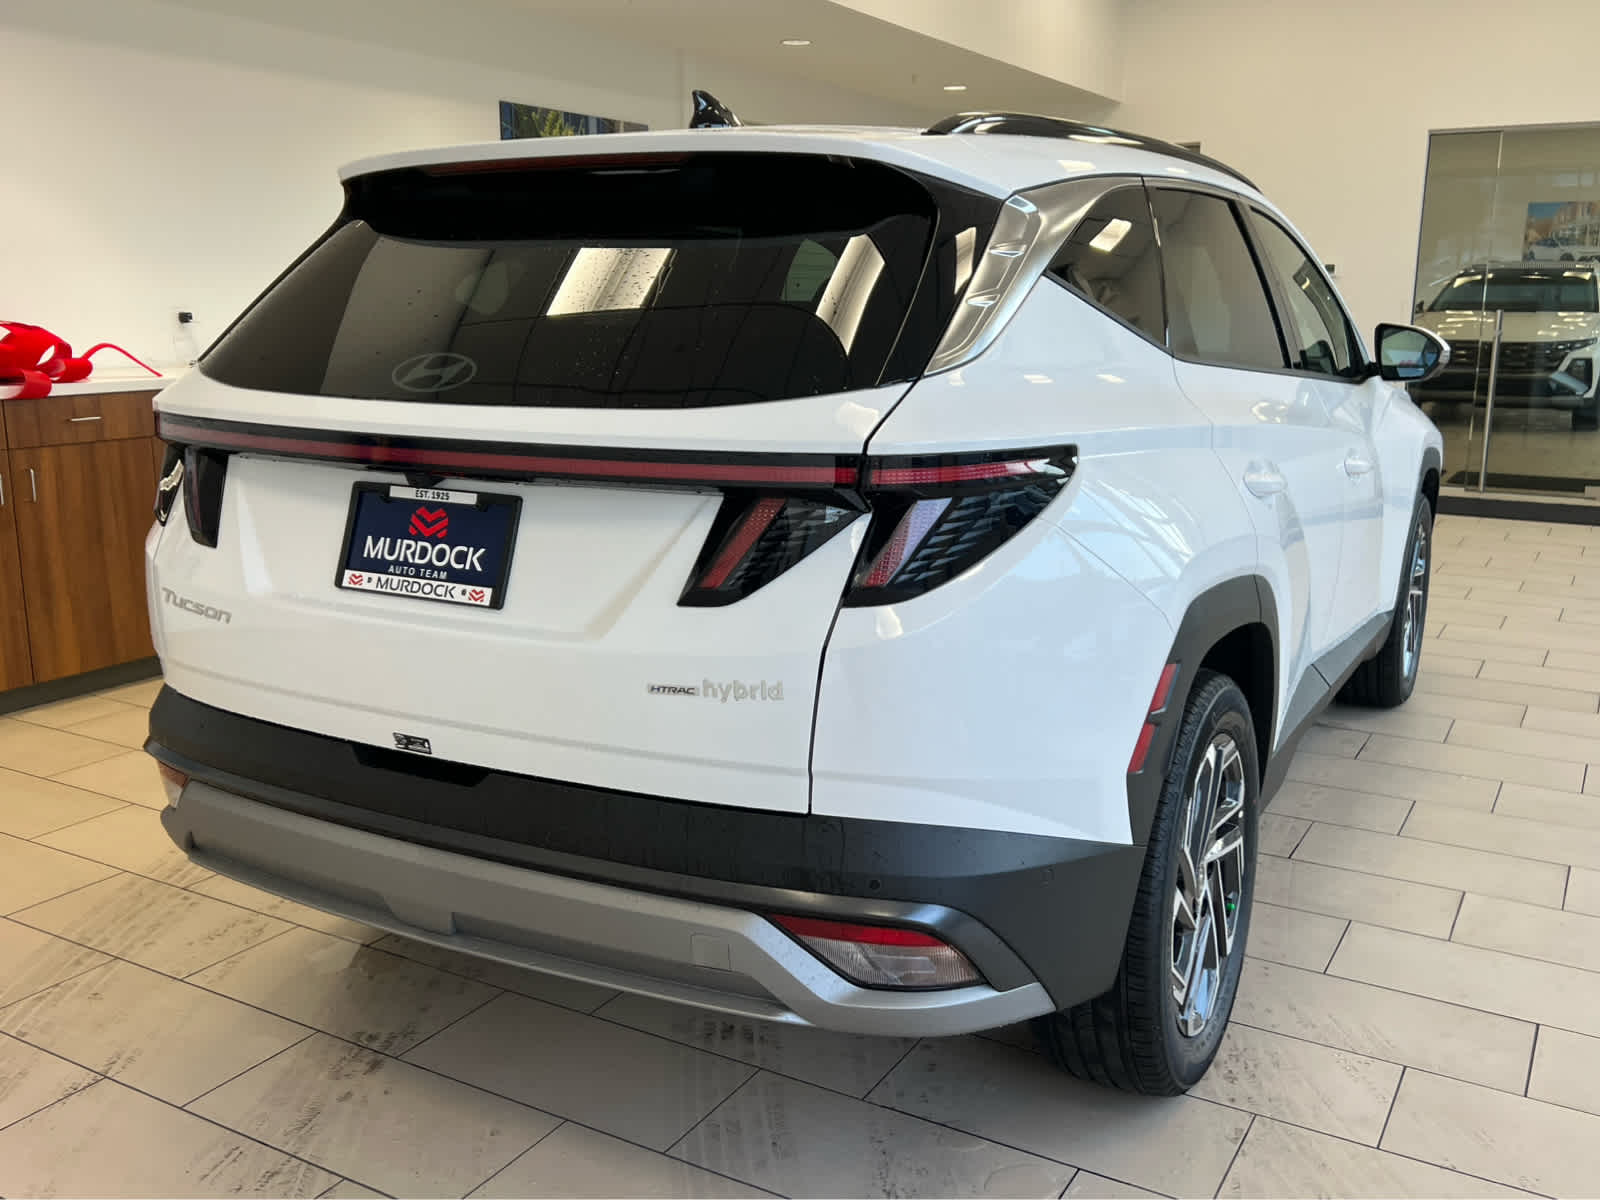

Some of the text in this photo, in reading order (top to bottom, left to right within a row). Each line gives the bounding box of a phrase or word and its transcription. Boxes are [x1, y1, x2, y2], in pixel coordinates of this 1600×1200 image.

[415, 489, 450, 501] EST. 1925
[363, 535, 486, 571] MURDOCK
[388, 565, 448, 580] AUTO TEAM
[375, 575, 456, 599] MURDOCK
[650, 678, 784, 704] HTRAC hybrid
